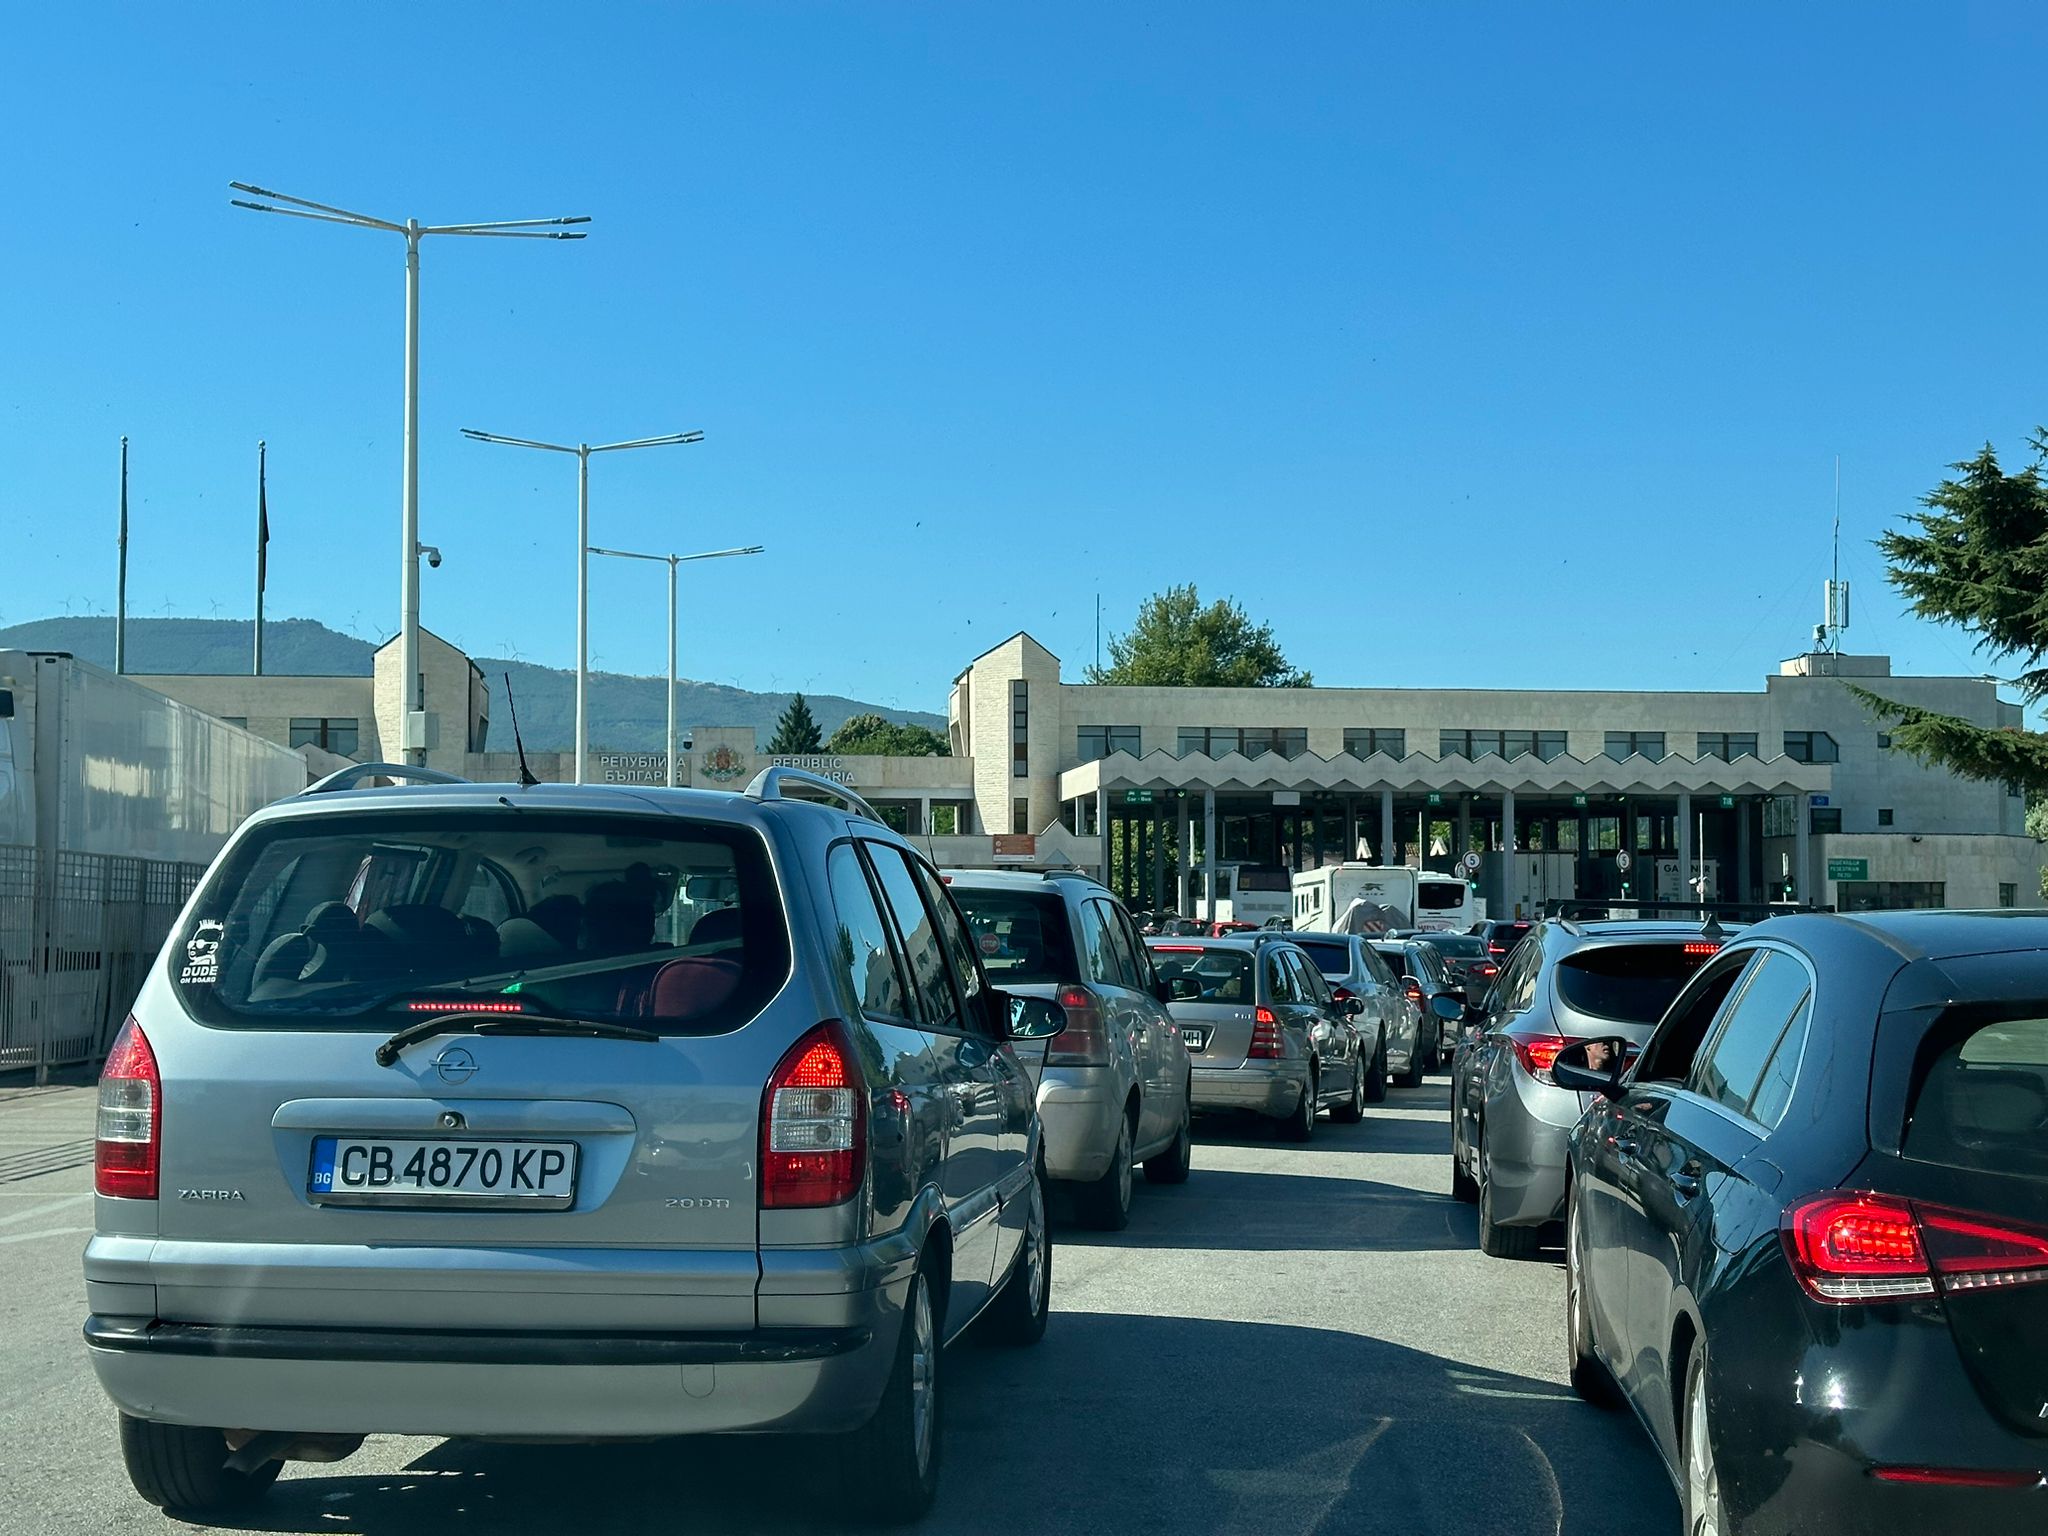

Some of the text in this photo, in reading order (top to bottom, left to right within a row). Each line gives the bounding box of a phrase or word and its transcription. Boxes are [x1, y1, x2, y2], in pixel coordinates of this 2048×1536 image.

[600, 756, 686, 768] РЕПУБЛИА
[772, 757, 842, 769] REPUBLIC
[1470, 855, 1476, 865] 5
[182, 966, 219, 977] DUDE
[314, 1146, 565, 1190] BG CB 4870 KP
[178, 1189, 246, 1201] ZAFIRA
[699, 1198, 730, 1209] DTI
